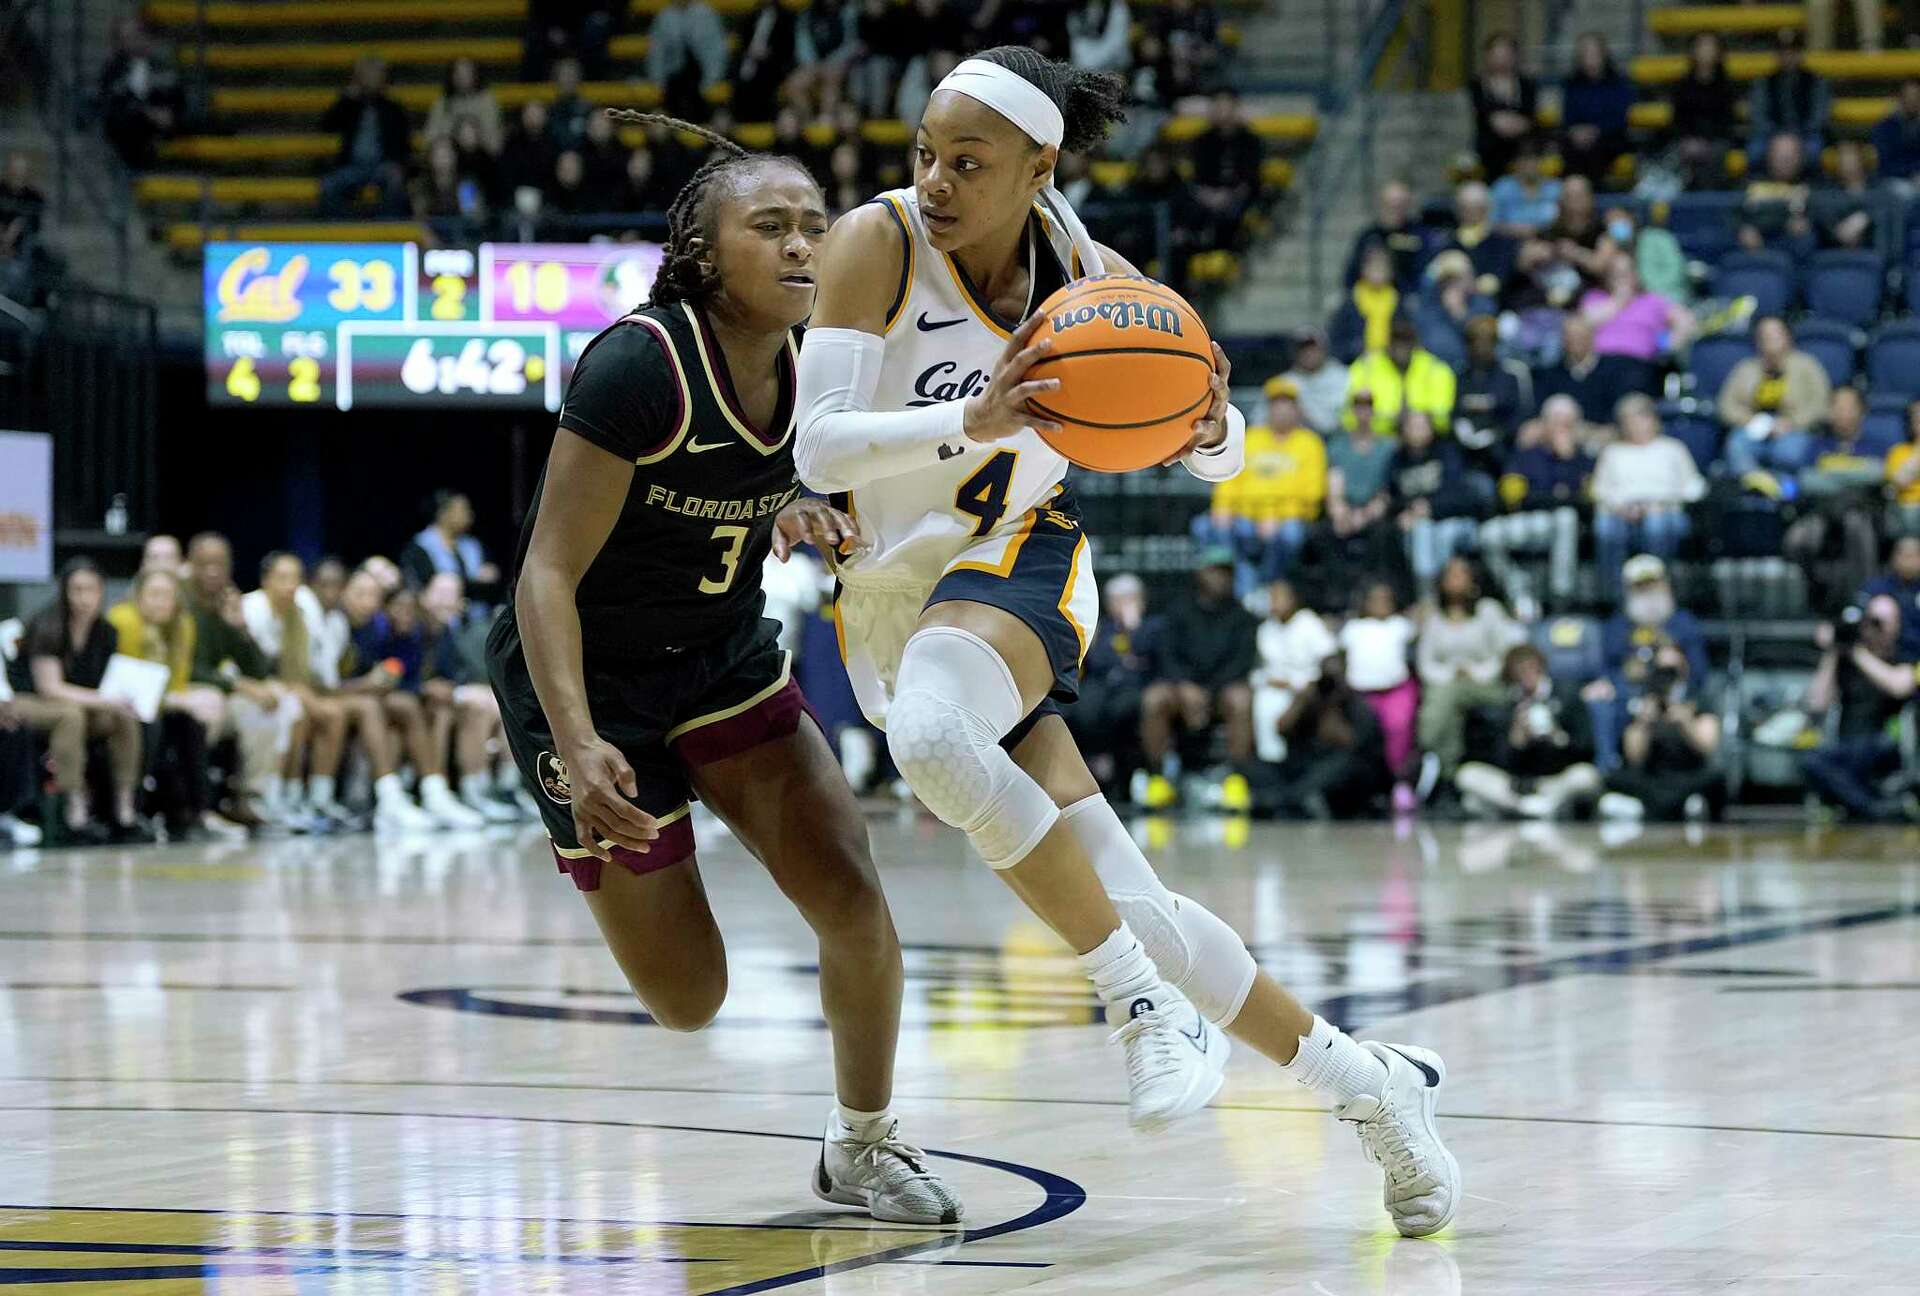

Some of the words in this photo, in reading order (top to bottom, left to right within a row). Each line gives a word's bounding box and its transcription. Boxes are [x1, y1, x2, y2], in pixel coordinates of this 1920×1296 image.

[218, 247, 308, 323] Cal
[328, 259, 396, 312] 33
[431, 274, 467, 320] 2
[1052, 301, 1183, 338] Wilson
[226, 355, 261, 402] 4
[287, 356, 321, 402] 2
[401, 338, 527, 394] 6:42
[912, 361, 990, 403] Cali
[645, 484, 753, 521] FLORIDA
[954, 449, 1019, 537] 4
[698, 525, 749, 595] 3
